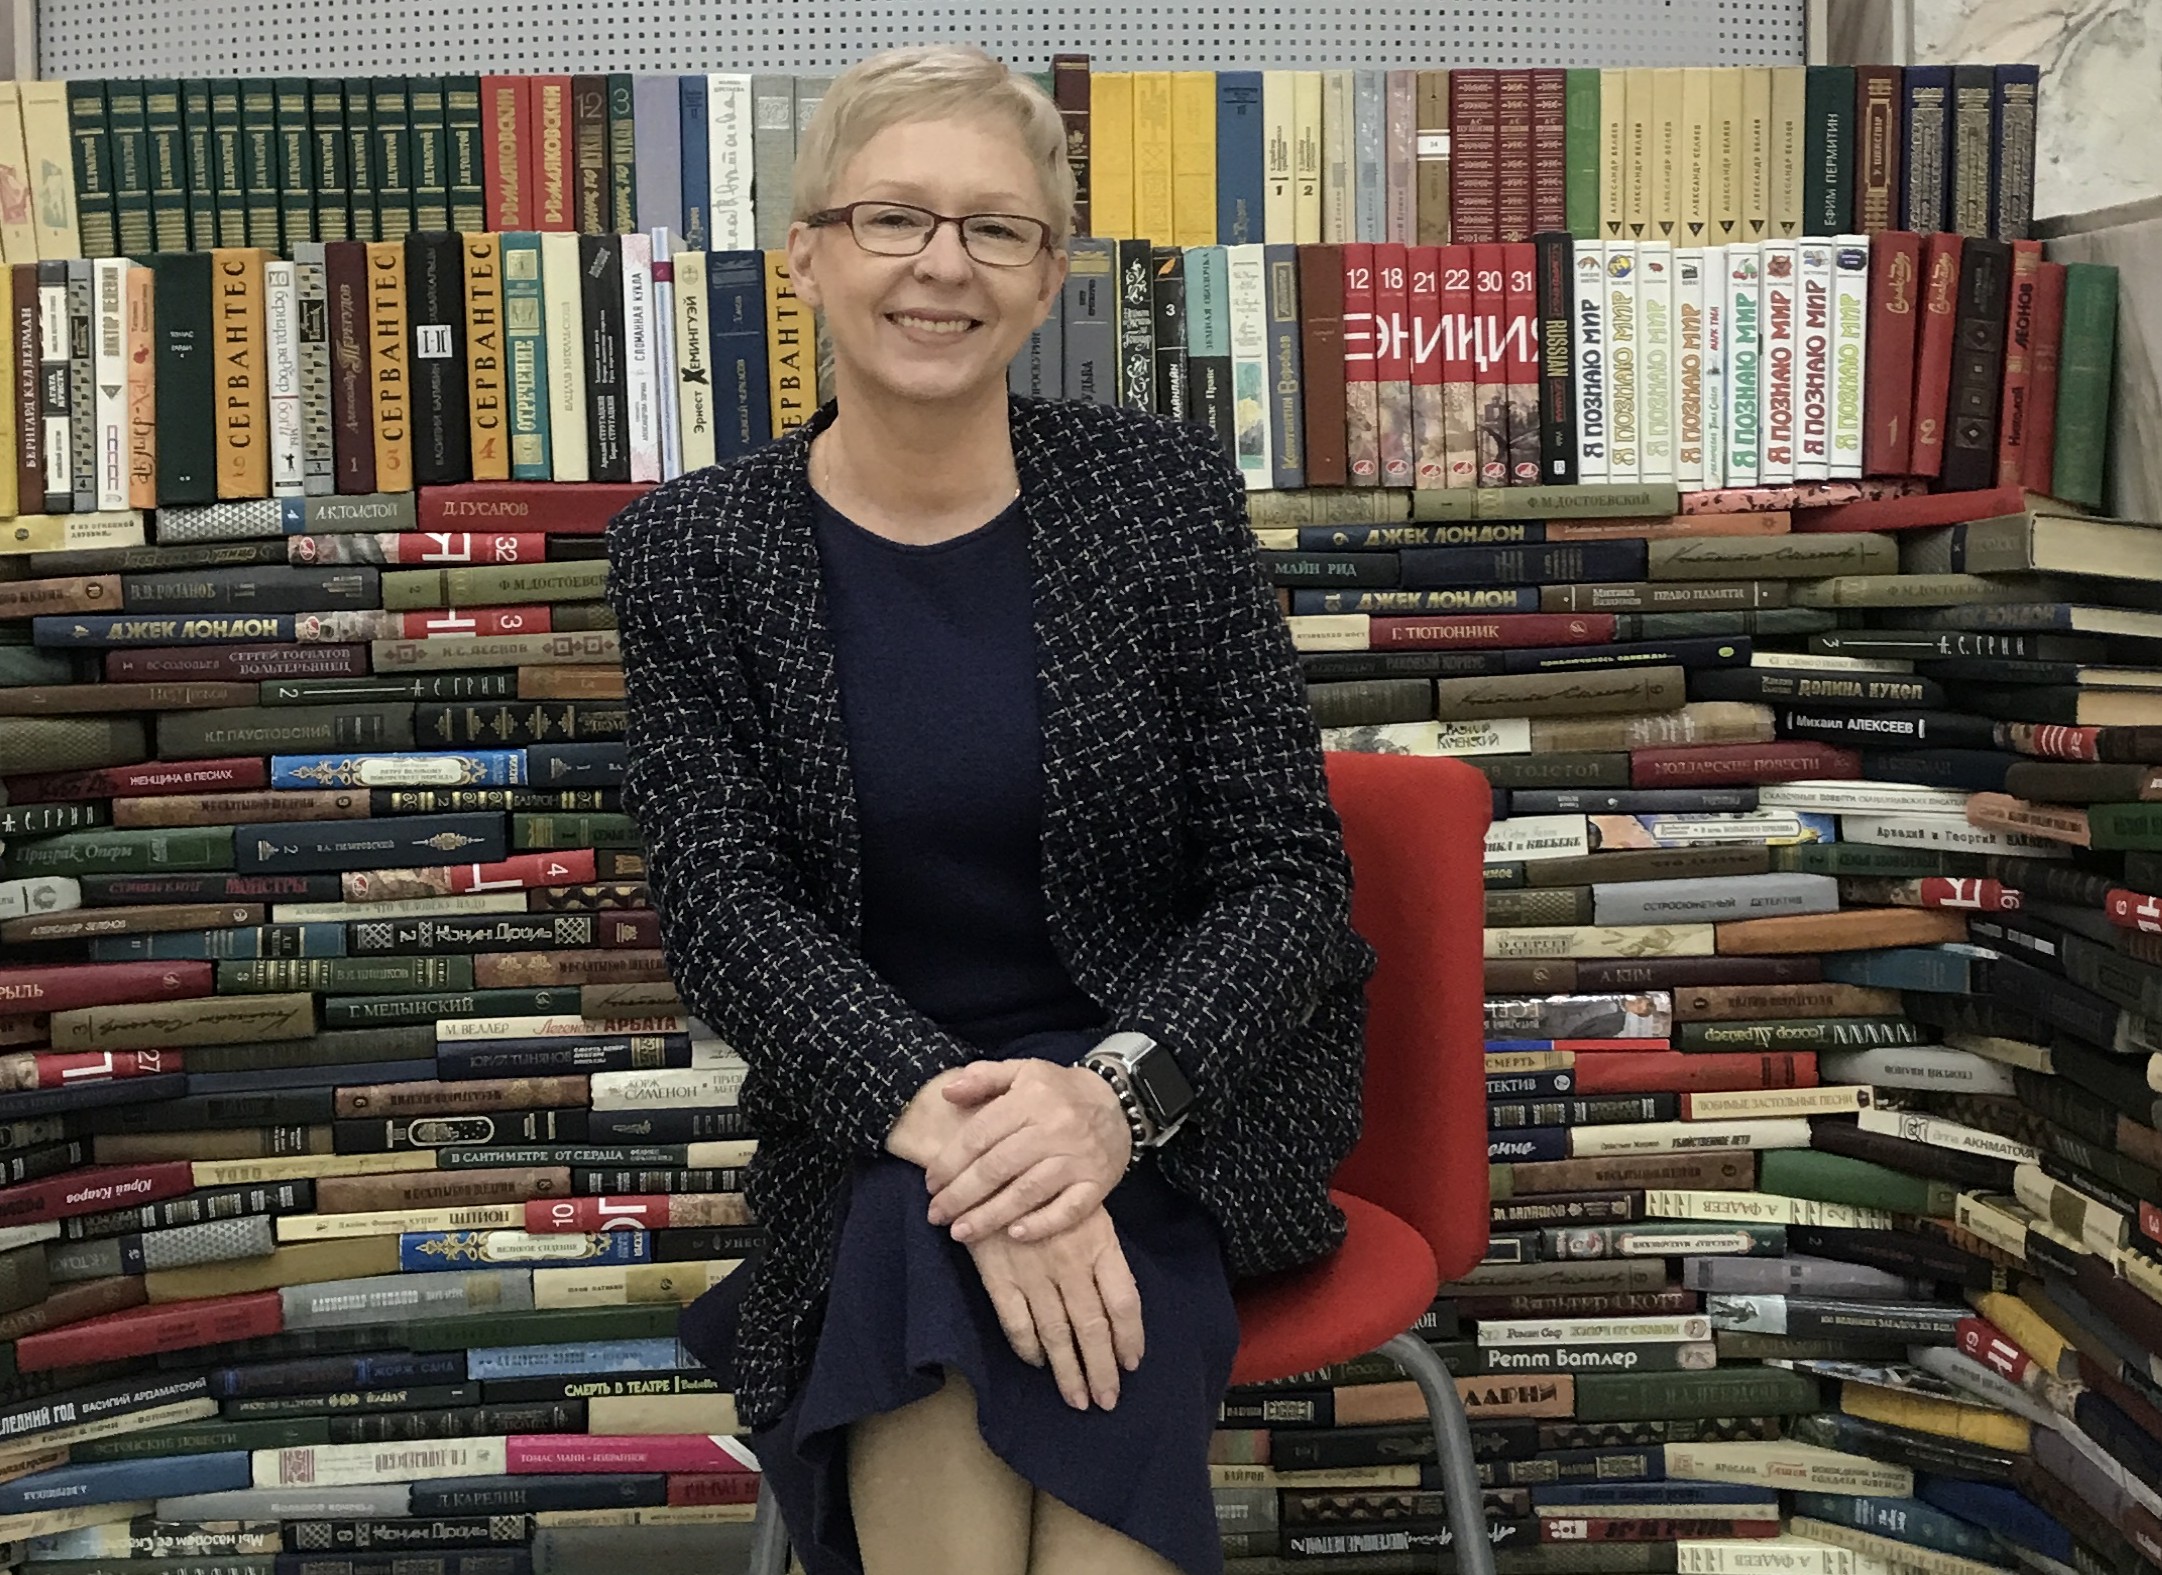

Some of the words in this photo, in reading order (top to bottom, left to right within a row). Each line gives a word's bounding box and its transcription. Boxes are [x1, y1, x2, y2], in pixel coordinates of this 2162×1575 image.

[612, 87, 631, 117] 3
[1827, 113, 1839, 184] ПЕРМИТИН
[1275, 185, 1284, 196] 1
[1303, 185, 1314, 197] 2
[1824, 190, 1837, 226] ЕФИМ
[633, 272, 643, 301] КУКЛА
[1347, 268, 1369, 289] 12
[1381, 267, 1403, 289] 18
[1413, 272, 1436, 292] 21
[1445, 269, 1470, 290] 22
[1477, 271, 1502, 291] 30
[1511, 271, 1532, 291] 31
[1165, 303, 1176, 317] 3
[1806, 279, 1827, 328] МИР
[1581, 299, 1600, 345] МИР
[1611, 290, 1633, 342] МИР
[1647, 299, 1667, 344] МИР
[1735, 292, 1757, 344] МИР
[1770, 290, 1791, 340] МИР
[1839, 293, 1861, 339] МИР
[2015, 283, 2033, 350] ЛЕОНОВ
[470, 243, 498, 430] СЕРВАНТЕС
[634, 304, 645, 361] СЛОМАННАЯ
[1681, 303, 1701, 350] МИР
[22, 306, 33, 396] КЕЛЛЕРМАН
[222, 260, 251, 448] СЕРВАНТЕС
[375, 255, 403, 441] СЕРВАНТЕС
[1545, 319, 1569, 377] RUSSIAN
[49, 370, 57, 404] АГАТА
[56, 369, 66, 408] КРИСТИ
[514, 340, 536, 432] ОТРЕЧЕНИЕ
[1582, 349, 1604, 437] ПОЗНАЮ
[1612, 347, 1635, 442] ПОЗНАЮ
[1648, 349, 1668, 436] ПОЗНАЮ
[1770, 347, 1792, 442] ПОЗНАЮ
[1805, 335, 1826, 436] ПОЗНАЮ
[1837, 343, 1860, 430] ПОЗНАЮ
[1681, 354, 1701, 442] ПОЗНАЮ
[1734, 350, 1757, 446] ПОЗНАЮ
[693, 391, 705, 433] Эрнест
[23, 400, 37, 468] БЕРНГАРД
[1835, 433, 1858, 450] Я
[1920, 418, 1936, 445] 2
[480, 437, 496, 460] 4
[1584, 440, 1604, 458] Я
[1612, 447, 1635, 466] Я
[1646, 440, 1668, 457] Я
[1680, 447, 1701, 464] Я
[1768, 446, 1791, 465] Я
[1803, 439, 1824, 456] Я
[1732, 450, 1757, 468] Я
[1365, 528, 1430, 546] ДЖЕК
[1433, 525, 1525, 543] ЛОНДОН
[496, 536, 518, 562] 32
[1275, 561, 1320, 575] МАЙН
[1327, 563, 1357, 577] РИД
[1355, 592, 1421, 610] ДЖЕК
[1426, 590, 1518, 608] ЛОНДОН
[1654, 591, 1690, 601] ПРАВО
[1693, 589, 1744, 600] ПАМЯТИ
[106, 620, 176, 640] ДЖЕК
[181, 618, 278, 637] ЛОНДОН
[500, 614, 523, 629] 3
[1976, 636, 2024, 656] ГРИН
[280, 687, 299, 699] 2
[455, 676, 506, 695] ГРИН
[1797, 678, 1862, 697] ДОЛИНА
[1868, 682, 1923, 700] КУКОЛ
[228, 723, 331, 742] ПАУСТОВСКИЙ
[1796, 715, 1843, 730] Михаил
[1847, 717, 1914, 734] АЛЕКСЕЕВ
[1515, 762, 1600, 777] ТОЛСТОЙ
[1754, 757, 1820, 772] ПОВЕСТИ
[130, 772, 183, 786] ЖЕНЩИНА
[44, 806, 94, 829] ГРИН
[1526, 837, 1581, 850] КВЕБЕКЕ
[1877, 826, 1925, 840] Аркадий
[1945, 829, 1997, 845] Георгий
[16, 843, 83, 866] Призрак
[85, 844, 132, 862] Оперы
[284, 845, 299, 854] 2
[547, 862, 568, 877] 4
[225, 877, 308, 894] МОНСТРЫ
[1750, 895, 1803, 908] ДЕТЕКТИВ
[400, 930, 416, 943] 2
[436, 924, 492, 943] Конан
[496, 922, 553, 940] Дойль
[1617, 968, 1652, 982] КИМ
[363, 996, 475, 1017] МЕДЫНСКИЙ
[445, 1024, 458, 1035] М.
[461, 1022, 509, 1035] ВЕЛЛЕР
[533, 1019, 602, 1035] Легенды
[603, 1016, 677, 1033] АРБАТА
[138, 1050, 161, 1073] 27
[511, 1050, 572, 1067] ТЫНЯНОВ
[1485, 1056, 1535, 1068] СМЕРТЬ
[624, 1086, 697, 1101] СИМЕНОН
[1752, 1096, 1817, 1108] ЗАСТОЛЬНЫЕ
[1819, 1094, 1853, 1106] ПЕСНИ
[451, 1153, 461, 1164] В
[462, 1150, 548, 1163] САНТИМЕТРЕ
[555, 1150, 573, 1161] ОТ
[574, 1149, 624, 1162] СЕРДЦА
[1962, 1135, 2036, 1158] AKHMATOVA
[66, 1186, 112, 1204] Кларов
[115, 1179, 152, 1197] Юрий
[552, 1203, 574, 1228] 10
[1703, 1200, 1762, 1214] ФАДЕЕВ
[449, 1211, 510, 1225] ШПИОН
[1488, 1350, 1550, 1367] Ретт
[1556, 1350, 1638, 1369] Батлер
[82, 1393, 131, 1414] ВАСИЛИЙ
[133, 1378, 207, 1403] АРДАМАТСКИЙ
[565, 1383, 611, 1397] СМЕРТЬ
[615, 1382, 624, 1394] В
[627, 1379, 670, 1394] ТЕАТРЕ
[54, 1402, 76, 1422] ГОД
[177, 1432, 238, 1447] ПОВЕСТИ
[521, 1454, 552, 1463] ТОМАС
[1223, 1469, 1265, 1482] БАЙРОН
[1733, 1555, 1795, 1568] ФАДЕЕВ
